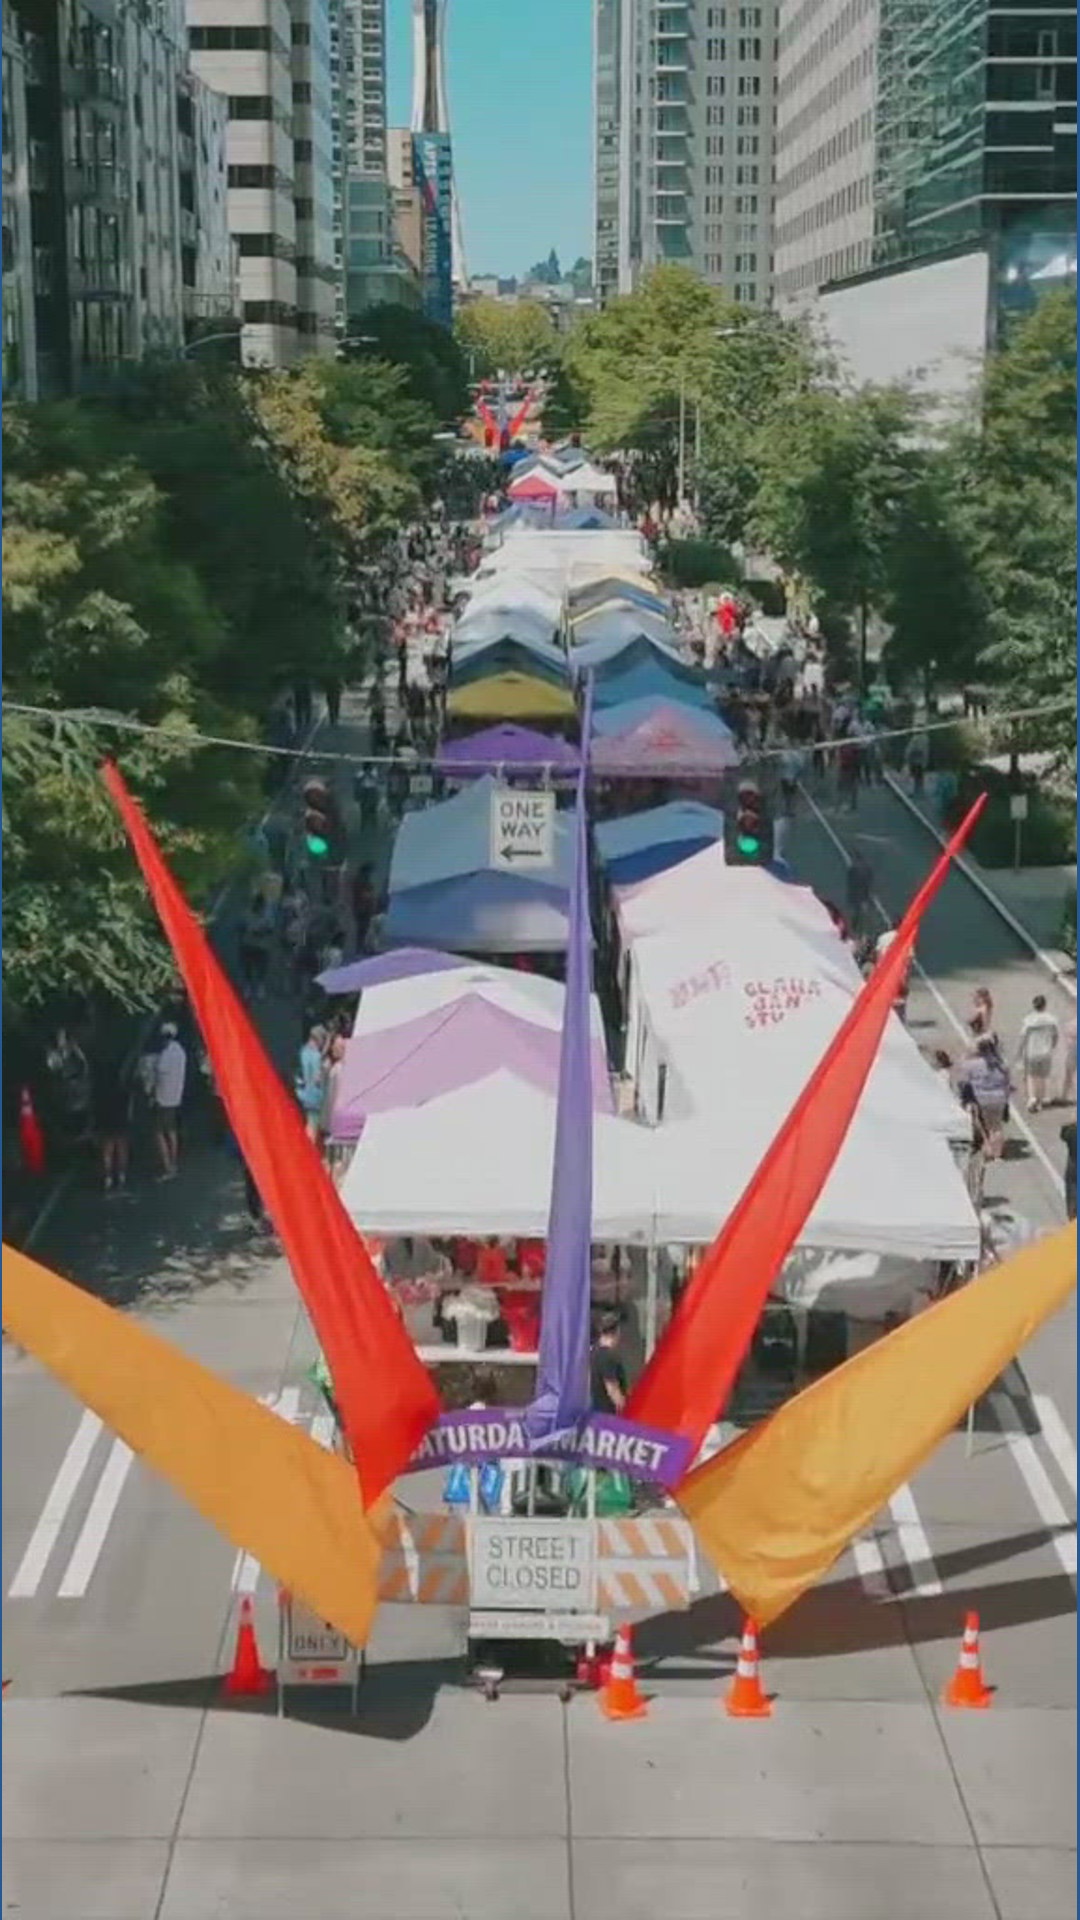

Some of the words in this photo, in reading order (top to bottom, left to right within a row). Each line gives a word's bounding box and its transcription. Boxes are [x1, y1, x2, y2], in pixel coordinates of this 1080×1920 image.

[500, 801, 544, 818] ONE
[501, 821, 546, 838] WAY
[409, 1419, 528, 1461] ATURDA
[488, 1535, 579, 1559] STREET
[486, 1564, 581, 1590] CLOSED
